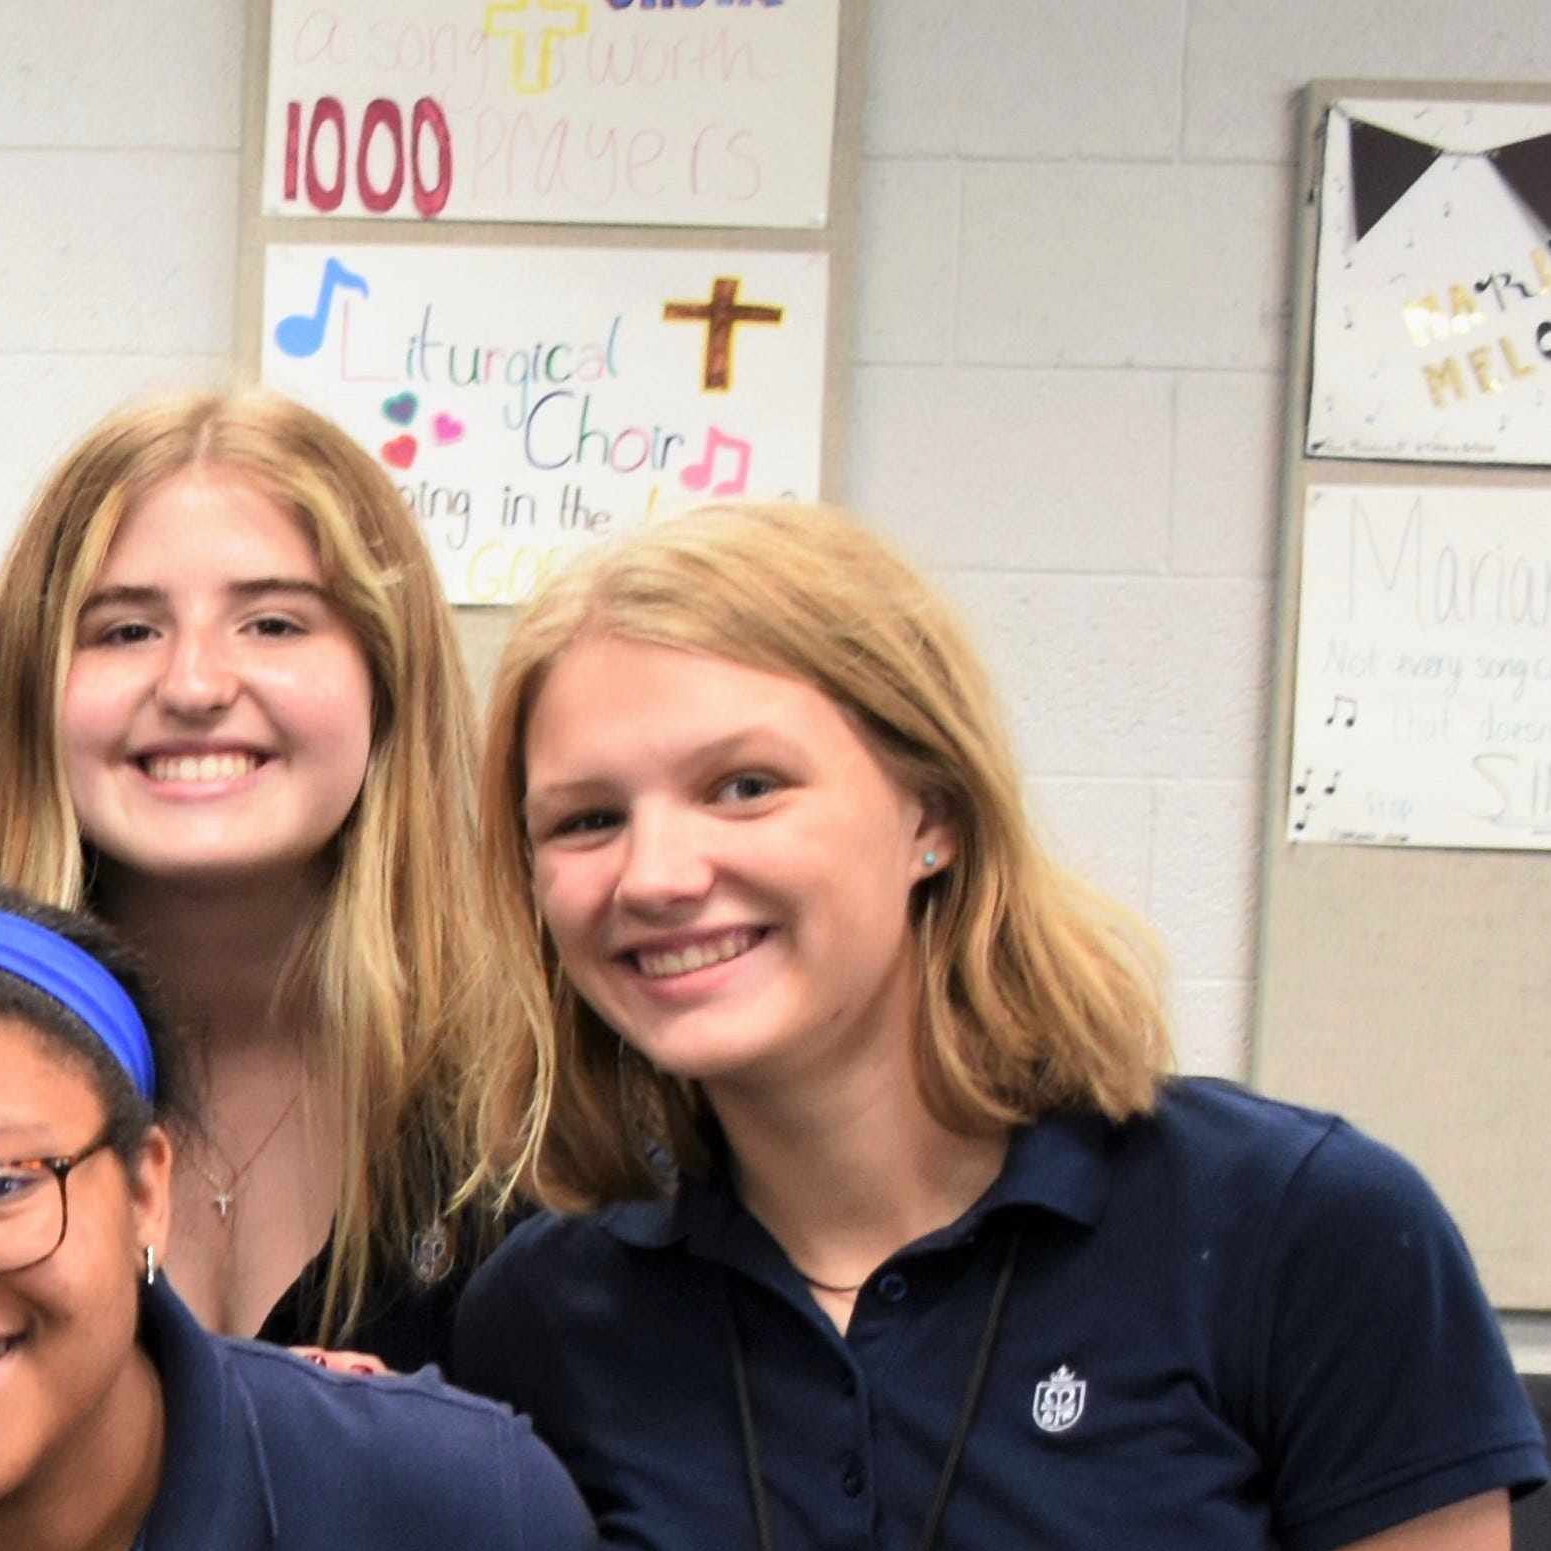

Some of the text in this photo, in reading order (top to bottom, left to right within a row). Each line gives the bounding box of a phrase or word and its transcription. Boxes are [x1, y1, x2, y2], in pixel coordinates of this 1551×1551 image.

[366, 22, 491, 109] song
[586, 24, 774, 87] worth
[283, 94, 454, 218] 1000
[340, 298, 626, 430] Liturgical
[524, 390, 685, 474] Choir
[501, 485, 537, 528] in
[559, 484, 612, 535] the
[1324, 638, 1380, 678] Not
[1395, 649, 1463, 699] every
[1476, 654, 1530, 702] song
